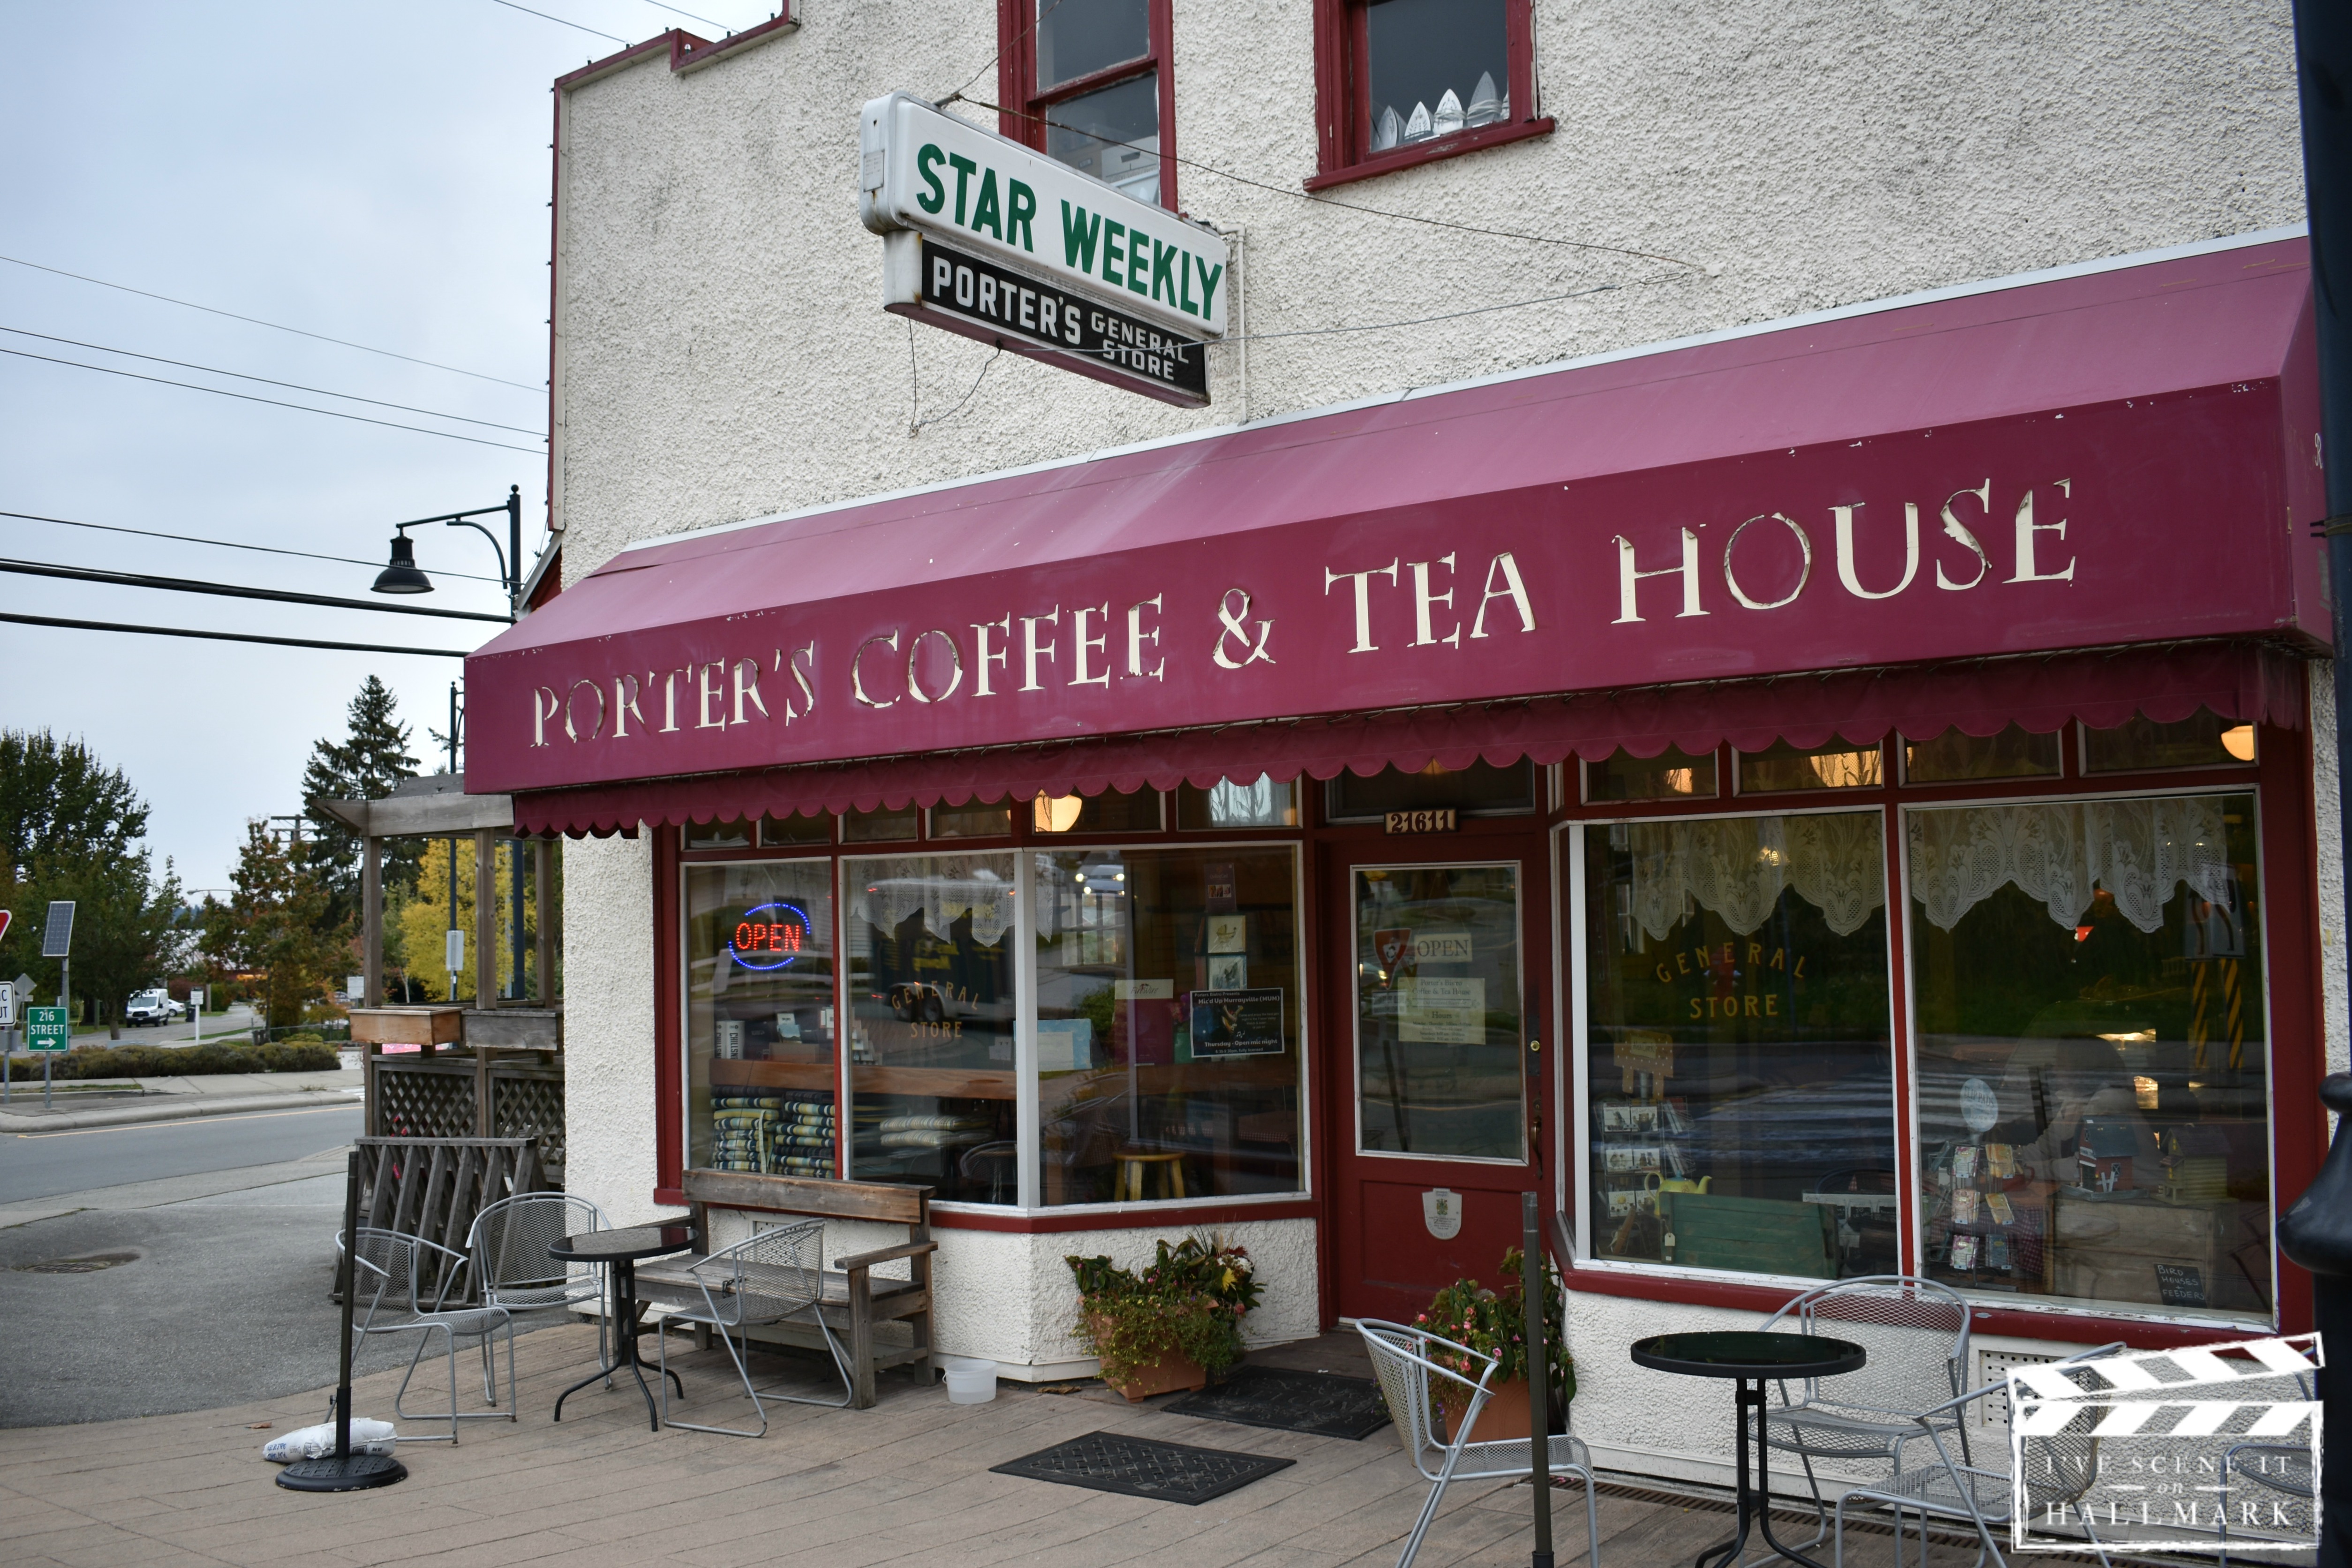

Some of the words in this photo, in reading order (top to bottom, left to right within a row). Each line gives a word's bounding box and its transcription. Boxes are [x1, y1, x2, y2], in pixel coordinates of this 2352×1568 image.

[916, 143, 1036, 253] STAR
[1061, 199, 1223, 321] WEEKLY
[933, 256, 1081, 345] PORTER'S
[1091, 311, 1189, 364] GENERAL
[1102, 339, 1174, 380] STORE
[530, 640, 815, 747] PORTER'S
[851, 588, 1165, 709] COFFEE
[1212, 588, 1276, 670] &
[1325, 550, 1538, 654] TEA
[1610, 477, 2076, 625] HOUSE
[1391, 810, 1450, 833] 21611
[736, 923, 800, 952] OPEN
[1417, 940, 1469, 957] OPEN
[1656, 941, 1807, 983] GENERAL
[891, 980, 979, 1010] GENERAL
[1690, 994, 1779, 1019] STORE
[39, 1010, 55, 1022] 216
[30, 1024, 65, 1035] STREET
[911, 1021, 963, 1038] STORE
[2157, 1264, 2184, 1276] BIRD
[2161, 1276, 2199, 1285] HOUSES
[2162, 1289, 2205, 1301] FEEDERS
